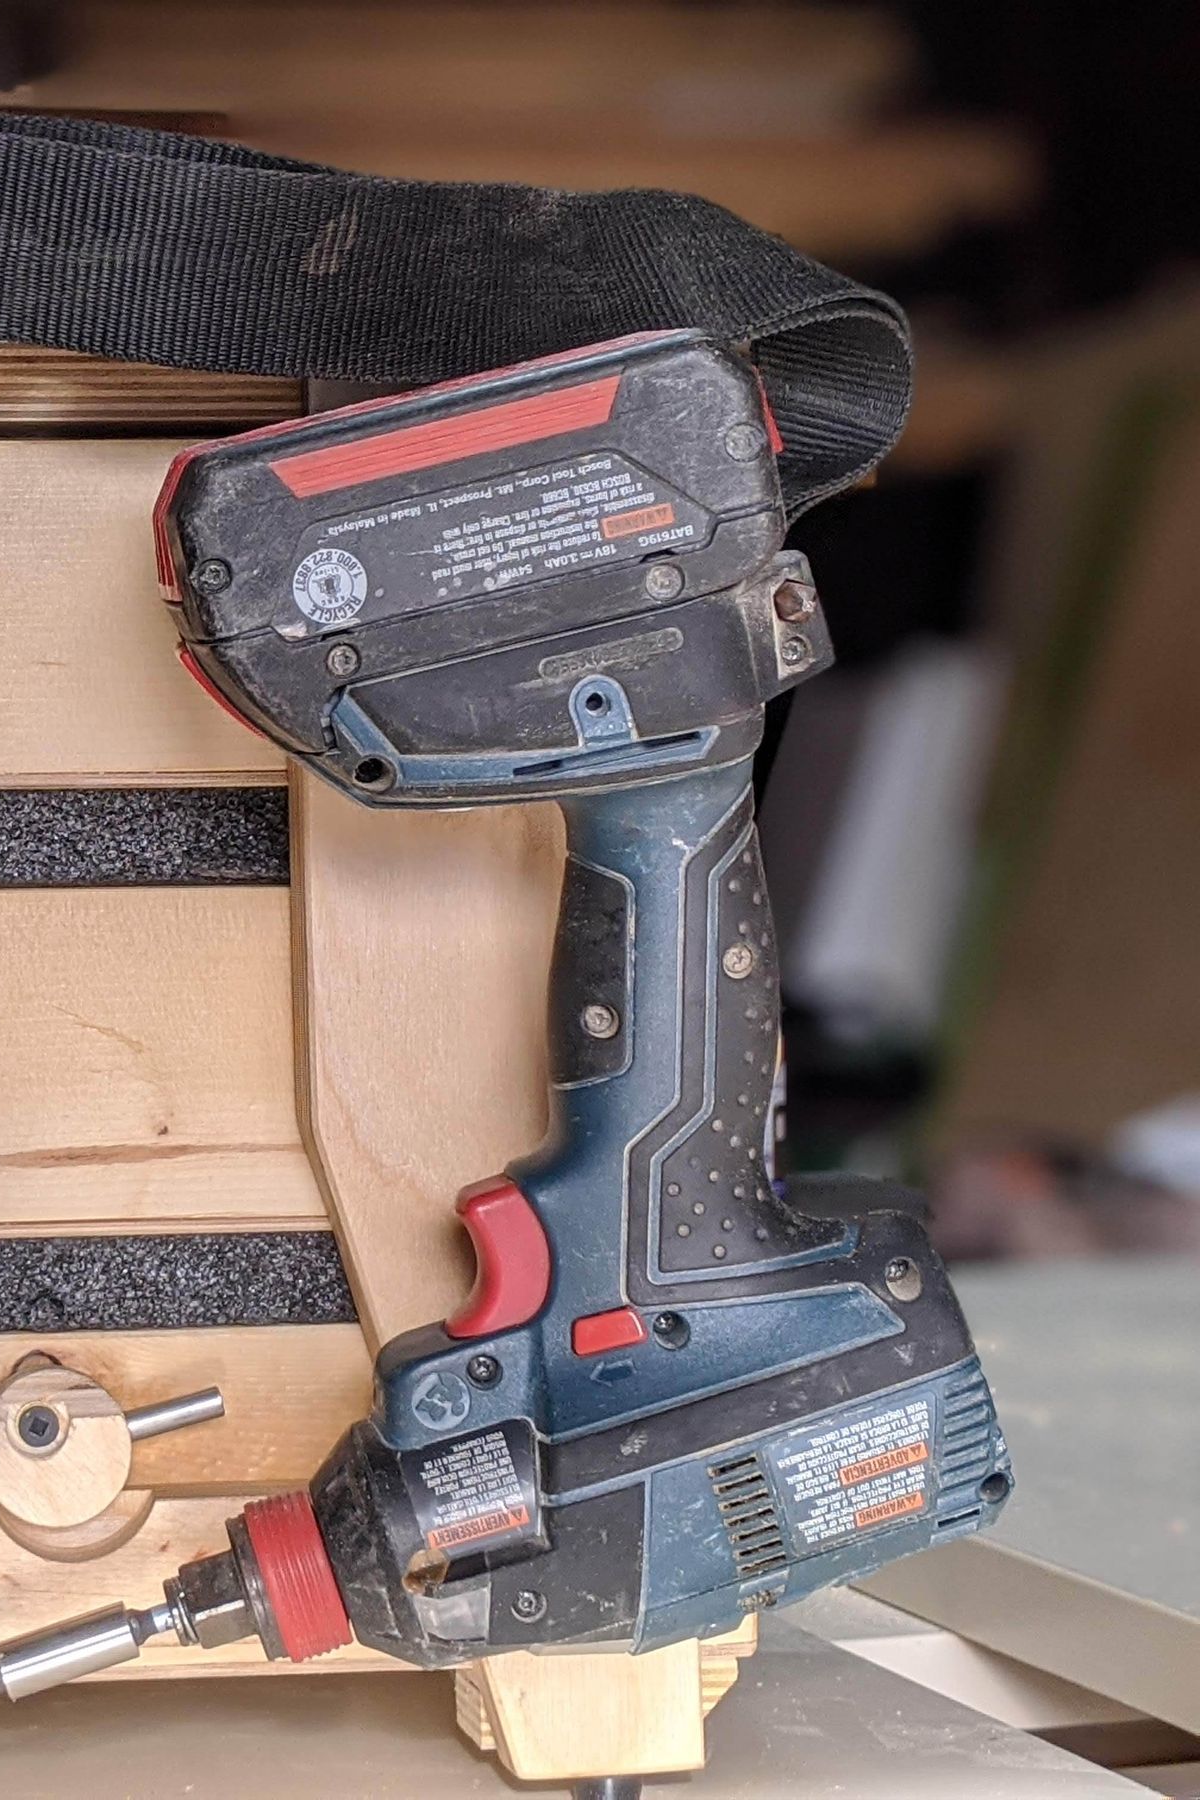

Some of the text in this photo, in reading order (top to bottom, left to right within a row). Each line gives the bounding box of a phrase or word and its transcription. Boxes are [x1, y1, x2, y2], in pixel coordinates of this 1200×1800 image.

[551, 468, 575, 481] Tool
[578, 459, 611, 474] Bosch
[439, 487, 492, 507] Prospect,
[494, 483, 513, 494] Mt.
[377, 514, 388, 524] in
[390, 506, 421, 520] Made
[327, 517, 375, 535] Malaysia
[638, 525, 693, 546] BAT619G
[308, 595, 361, 621] RECYCLE
[843, 1450, 908, 1480] ADVERTENCIA
[858, 1499, 905, 1522] WARNING
[433, 1514, 509, 1545] AVERTISSEMENT
